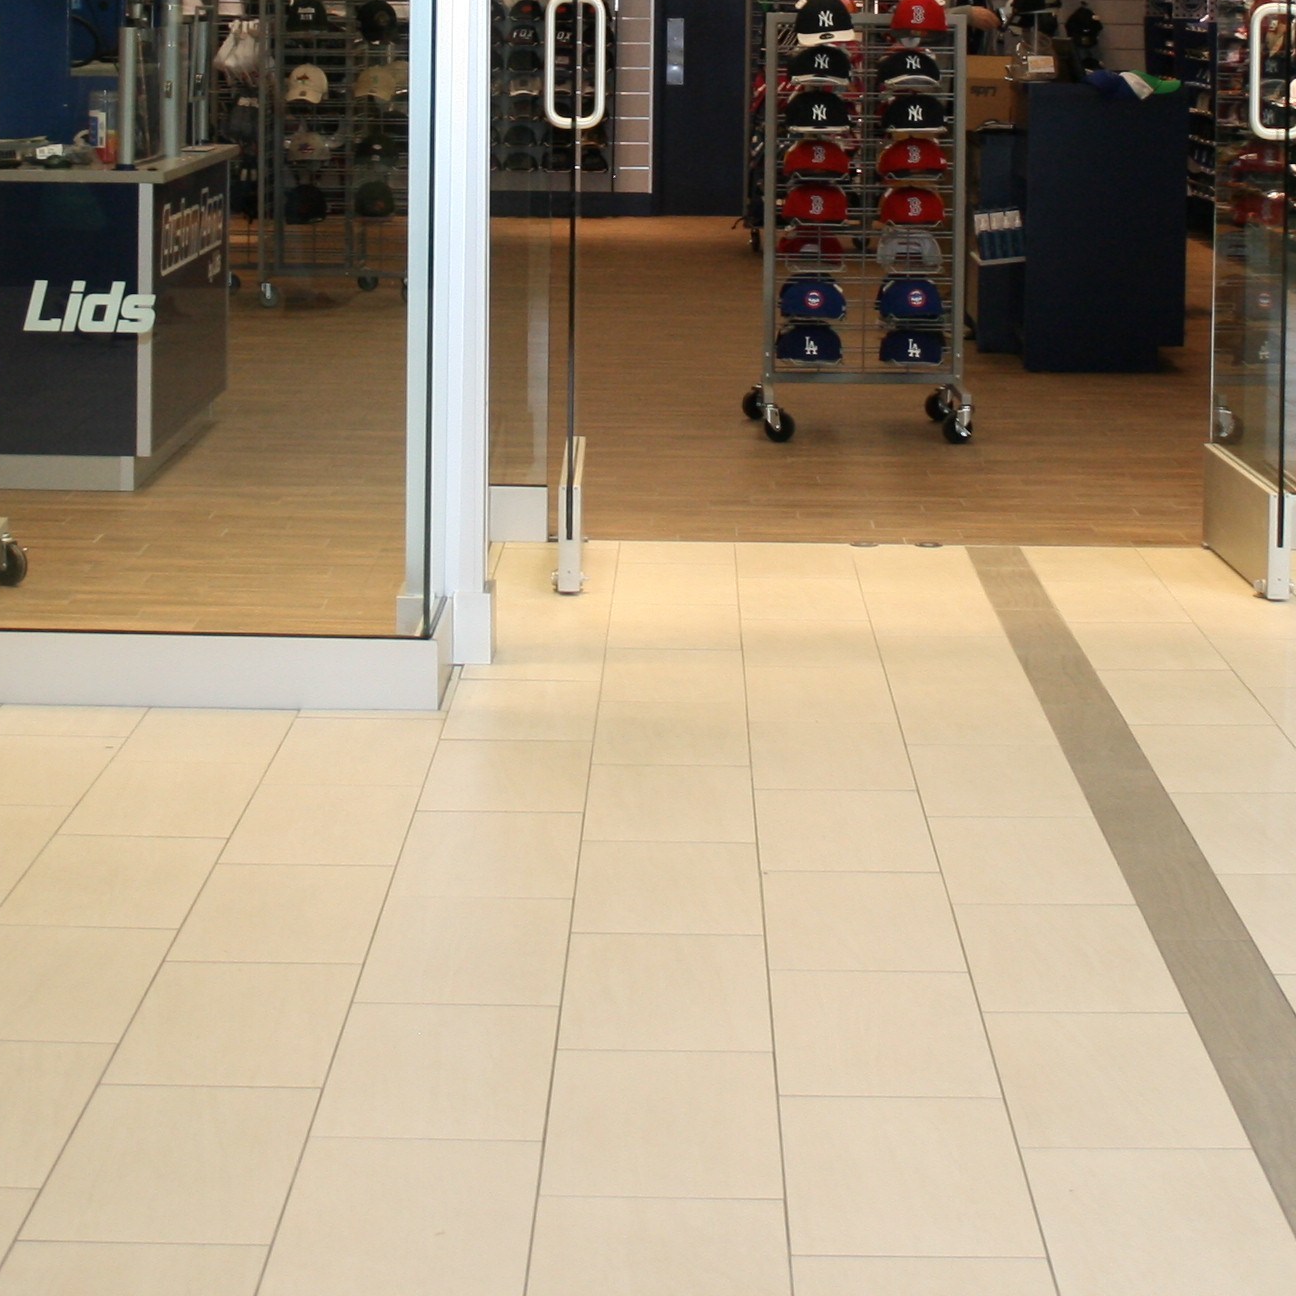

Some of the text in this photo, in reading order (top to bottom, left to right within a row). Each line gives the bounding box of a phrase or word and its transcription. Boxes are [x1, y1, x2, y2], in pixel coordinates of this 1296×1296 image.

[23, 280, 157, 334] Lids
[805, 336, 818, 355] LA
[907, 338, 921, 358] LA
